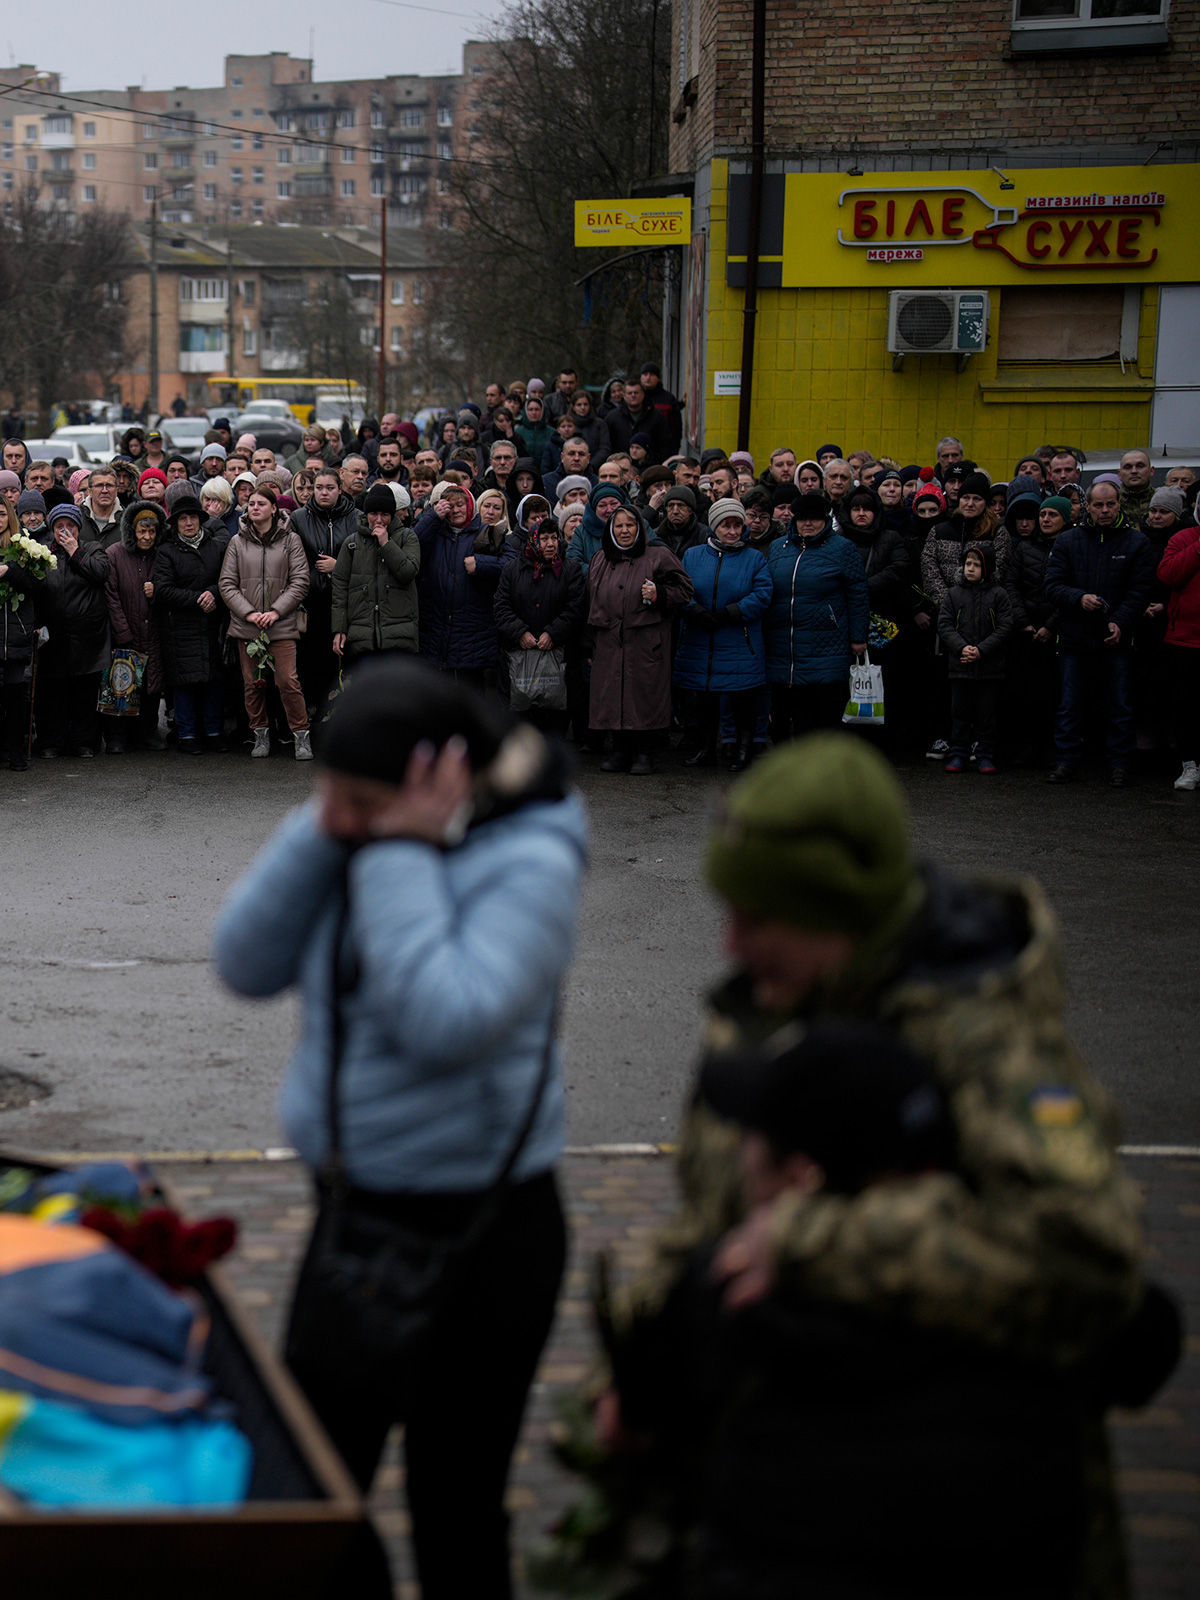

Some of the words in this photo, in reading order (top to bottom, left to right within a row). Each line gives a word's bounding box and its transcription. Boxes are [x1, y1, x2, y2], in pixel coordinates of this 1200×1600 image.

[1027, 193, 1106, 207] магазинів
[1112, 191, 1165, 205] напоїв
[587, 213, 623, 226] БІЛЕ
[853, 198, 966, 237] БІЛЕ
[641, 219, 677, 232] СУХЕ
[1026, 218, 1143, 258] СУХЕ
[868, 249, 923, 262] мережа
